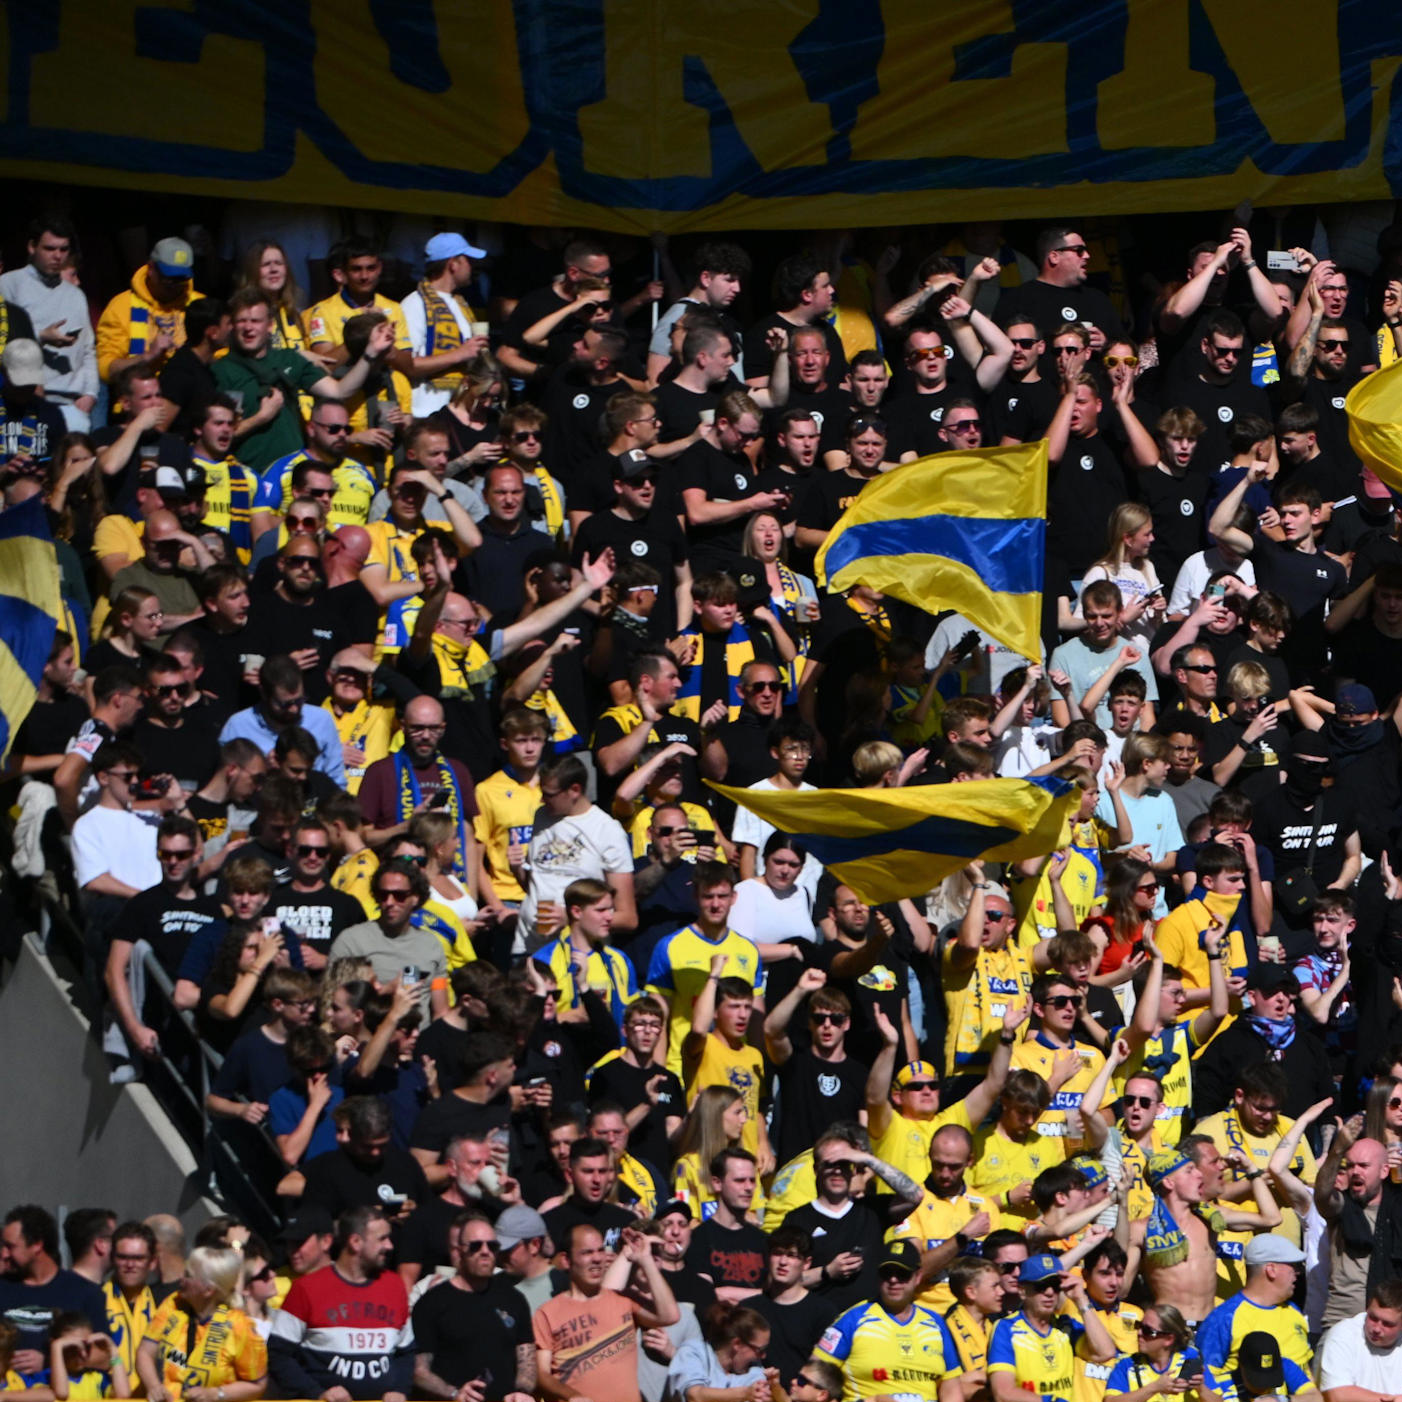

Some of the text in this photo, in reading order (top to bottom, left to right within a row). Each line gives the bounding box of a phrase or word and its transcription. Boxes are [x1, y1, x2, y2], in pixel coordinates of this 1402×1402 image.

[1281, 824, 1338, 838] SINTUIN
[276, 905, 333, 917] BLOED
[326, 1302, 395, 1325] PETROL
[348, 1332, 388, 1350] 1973
